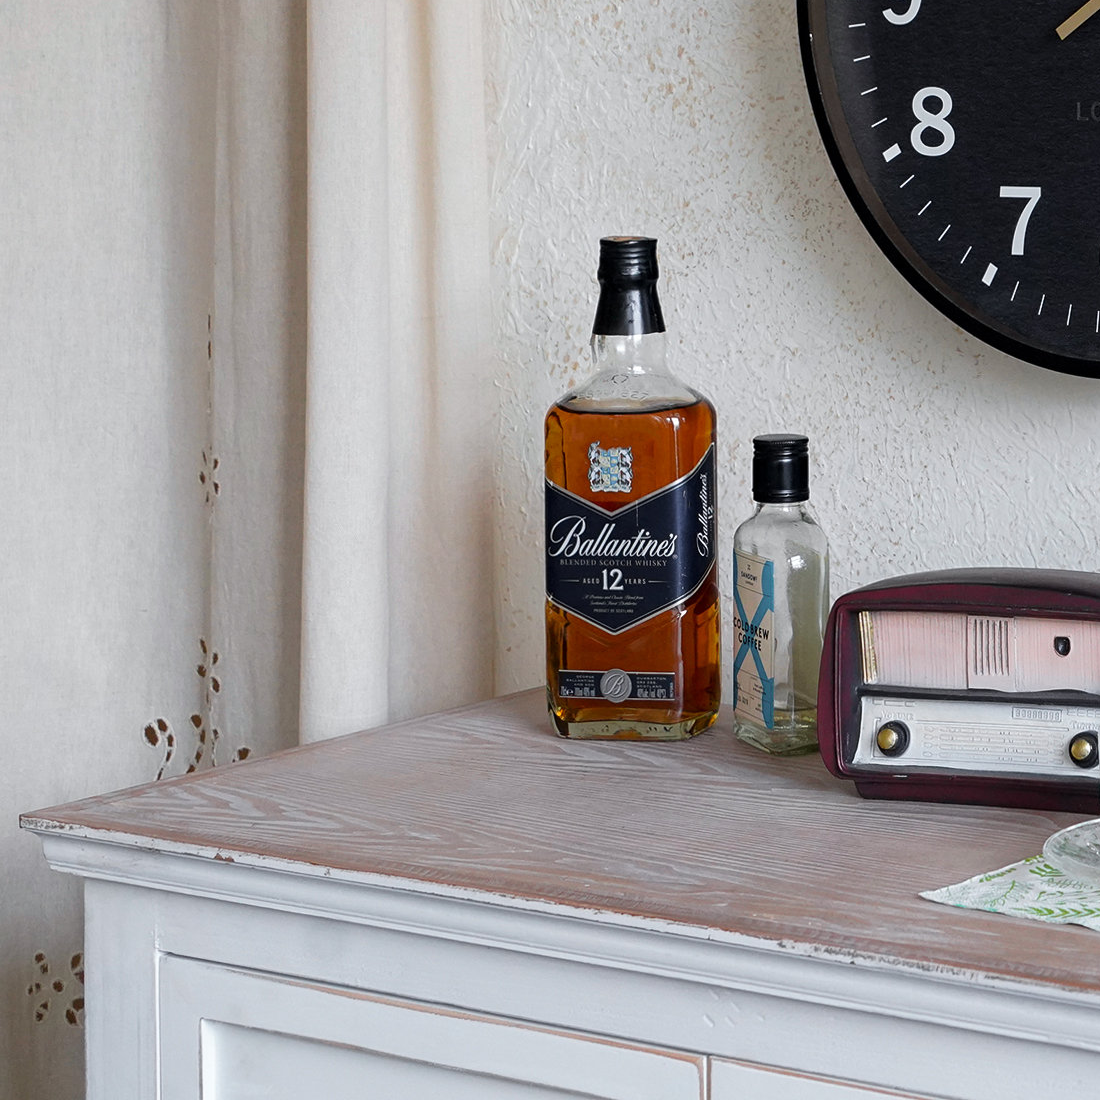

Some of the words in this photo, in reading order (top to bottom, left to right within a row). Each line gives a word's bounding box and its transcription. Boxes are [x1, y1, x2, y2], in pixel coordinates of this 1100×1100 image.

[911, 87, 955, 156] 8
[1000, 186, 1041, 255] 7
[548, 515, 678, 557] Ballantine's
[601, 568, 624, 590] 12
[733, 616, 749, 632] COLD
[750, 624, 769, 640] BREW
[738, 632, 762, 651] COFFEE
